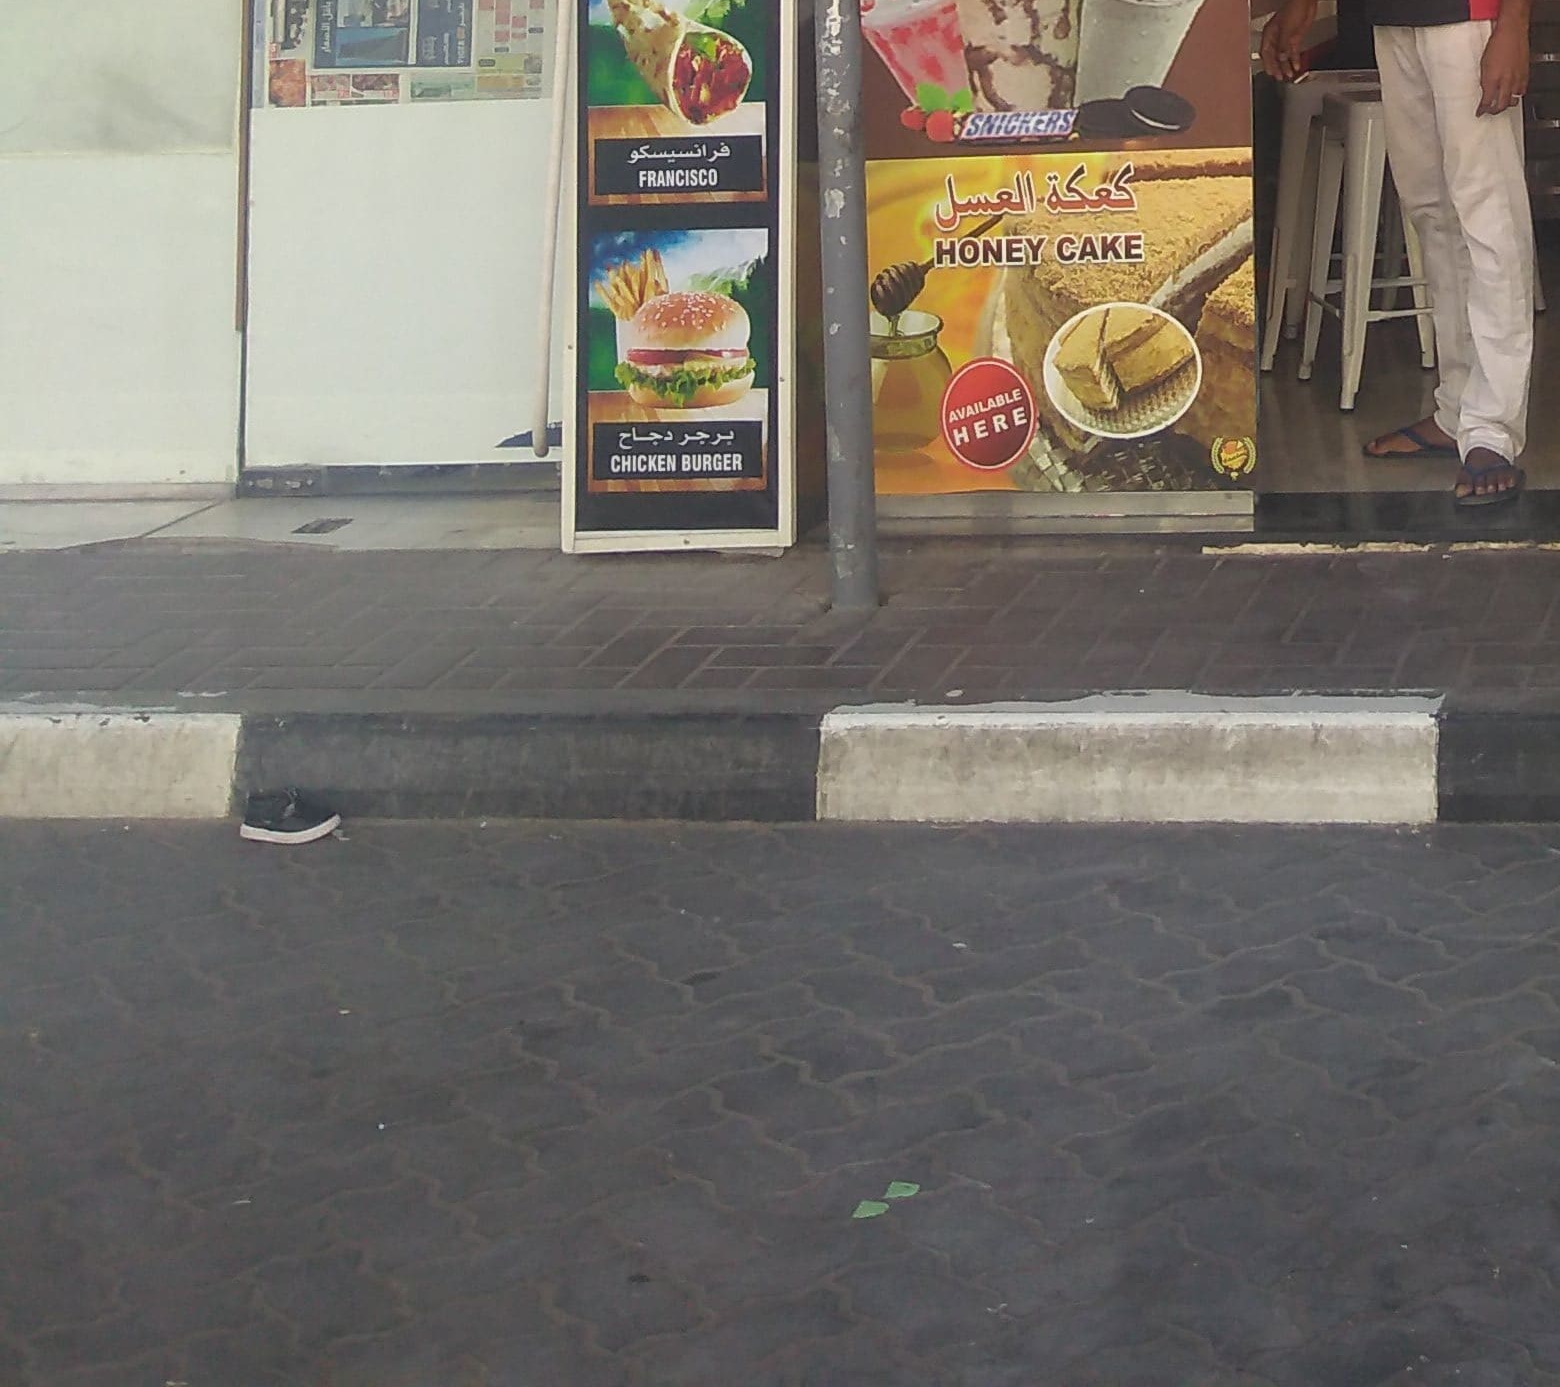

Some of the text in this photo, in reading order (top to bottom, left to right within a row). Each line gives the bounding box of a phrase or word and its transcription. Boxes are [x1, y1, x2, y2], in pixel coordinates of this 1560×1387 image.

[966, 109, 1077, 137] SNICKERS
[638, 168, 718, 188] FRANCISCO
[934, 161, 1137, 231] كعكة العسل
[934, 233, 1144, 266] HONEY CAKE
[949, 388, 1023, 424] AVAILABLE
[953, 406, 1028, 447] HERE
[610, 453, 743, 473] CHICKEN BURGER
